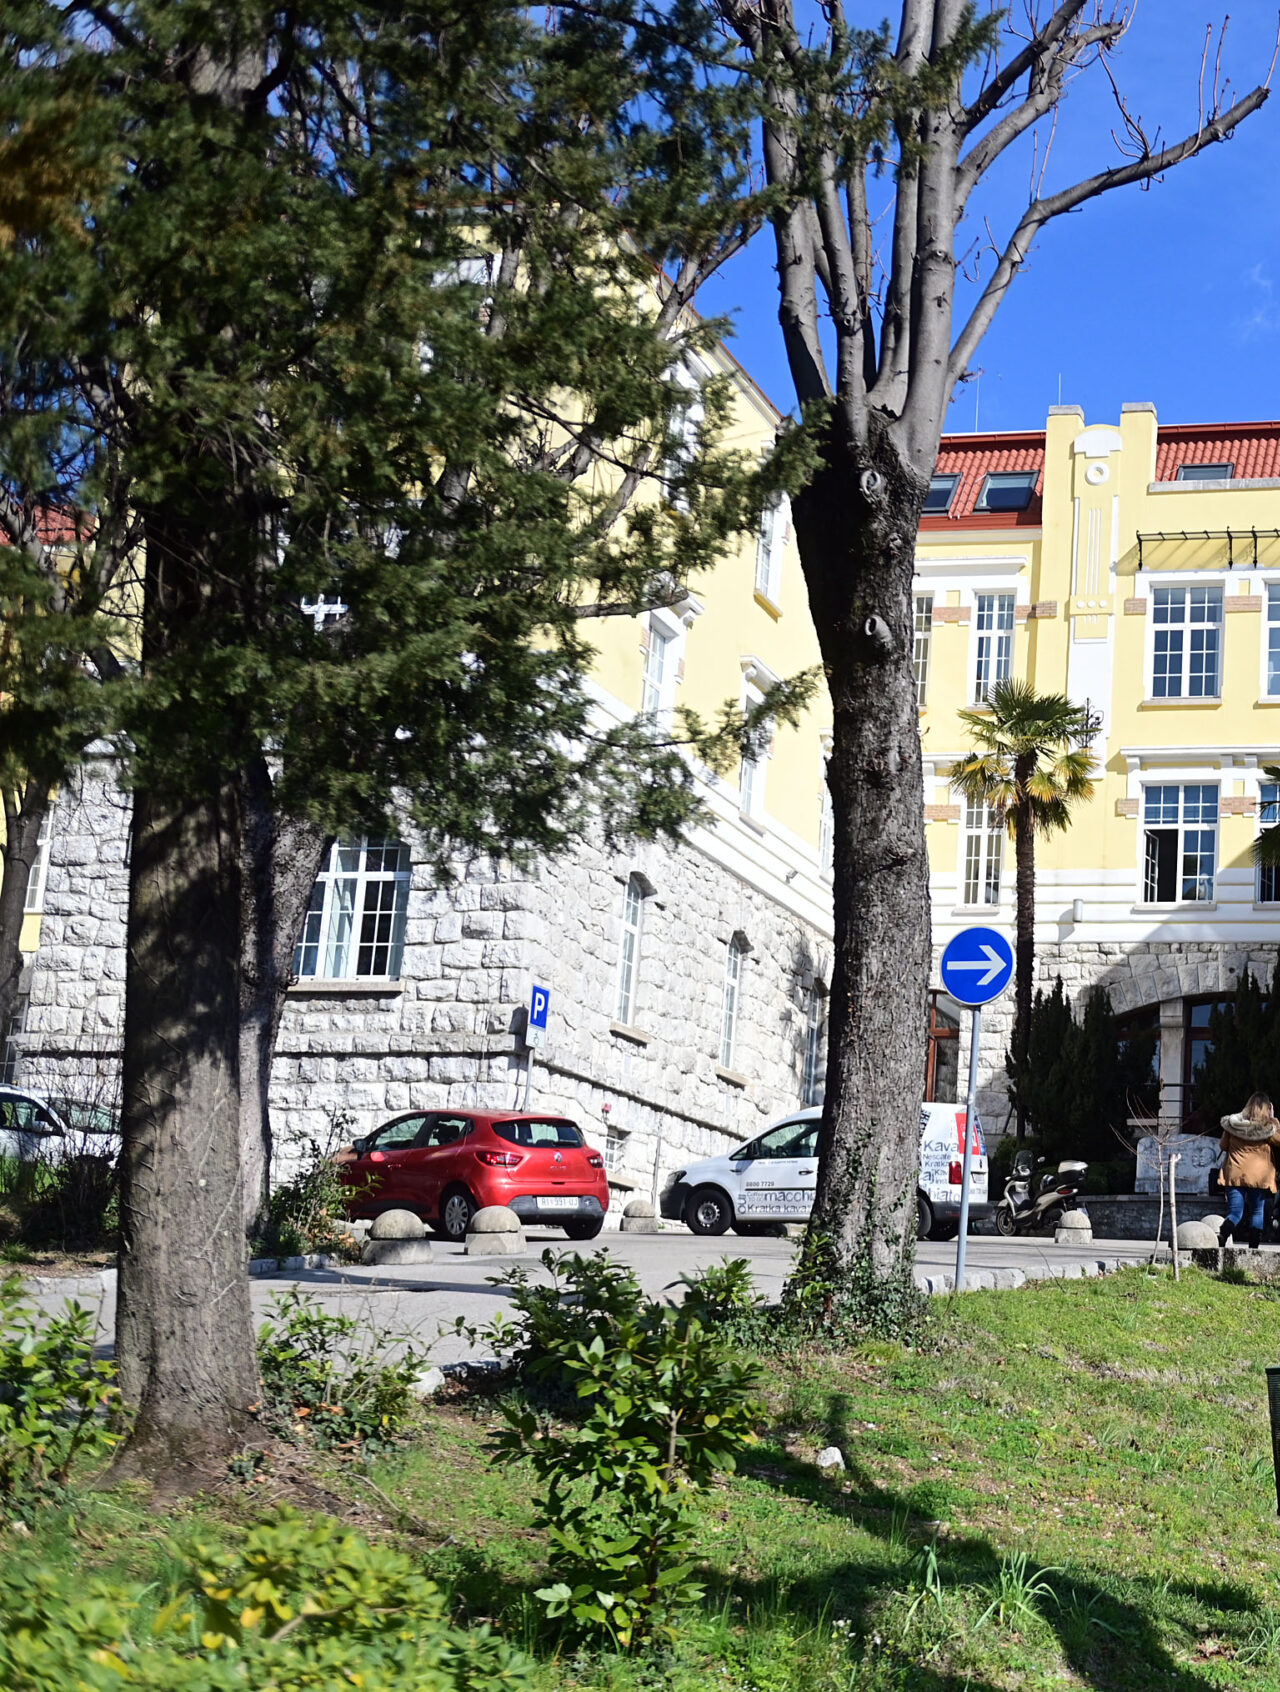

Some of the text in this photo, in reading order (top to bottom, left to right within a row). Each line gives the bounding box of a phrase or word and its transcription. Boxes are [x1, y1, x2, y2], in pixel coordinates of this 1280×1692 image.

[533, 992, 546, 1020] P
[923, 1140, 959, 1152] Kava
[748, 1204, 781, 1213] Kratka
